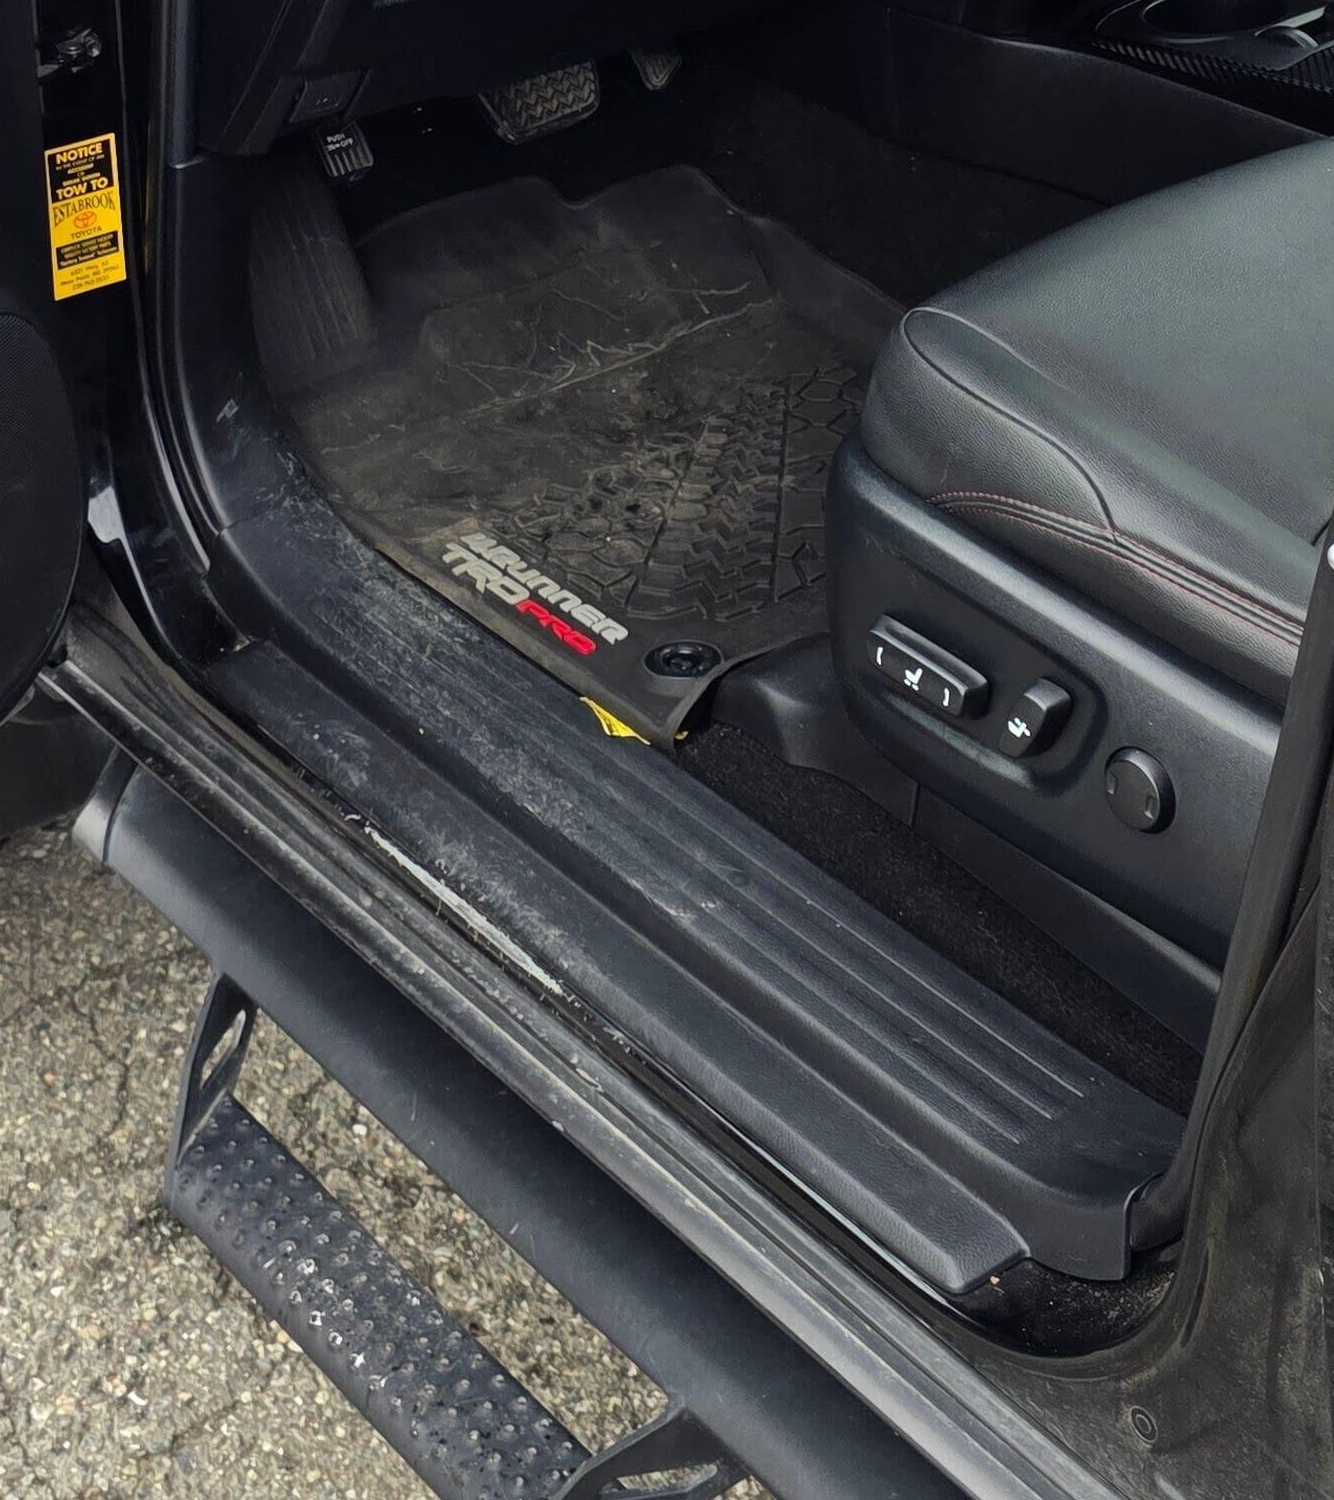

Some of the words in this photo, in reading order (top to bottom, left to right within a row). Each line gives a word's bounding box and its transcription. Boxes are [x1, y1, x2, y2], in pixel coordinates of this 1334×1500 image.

[55, 142, 103, 165] NOTICE
[55, 182, 87, 200] TOW
[90, 176, 108, 191] TO
[52, 190, 116, 228] ESTABROOK
[70, 225, 103, 240] TOYOTA
[442, 542, 531, 606] TRD
[516, 599, 598, 655] PRO
